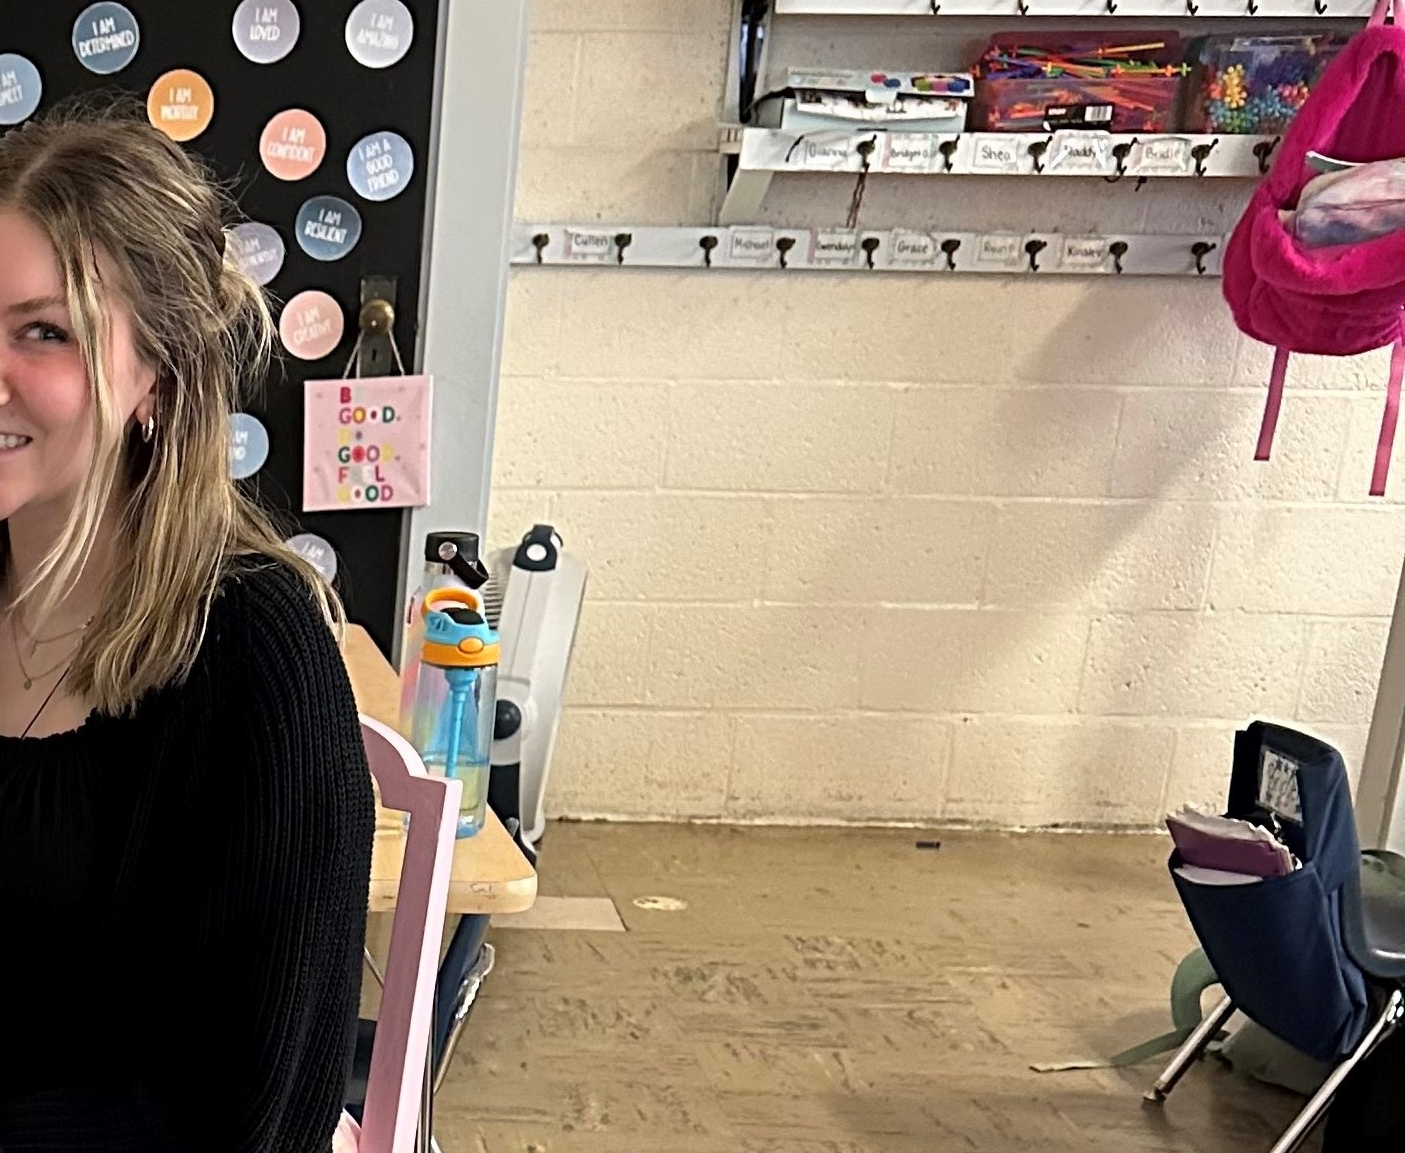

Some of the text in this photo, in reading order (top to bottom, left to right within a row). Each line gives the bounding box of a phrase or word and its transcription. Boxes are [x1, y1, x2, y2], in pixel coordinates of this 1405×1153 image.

[99, 17, 116, 34] AM
[78, 30, 135, 58] DETERMINED
[981, 146, 1011, 161] Shea
